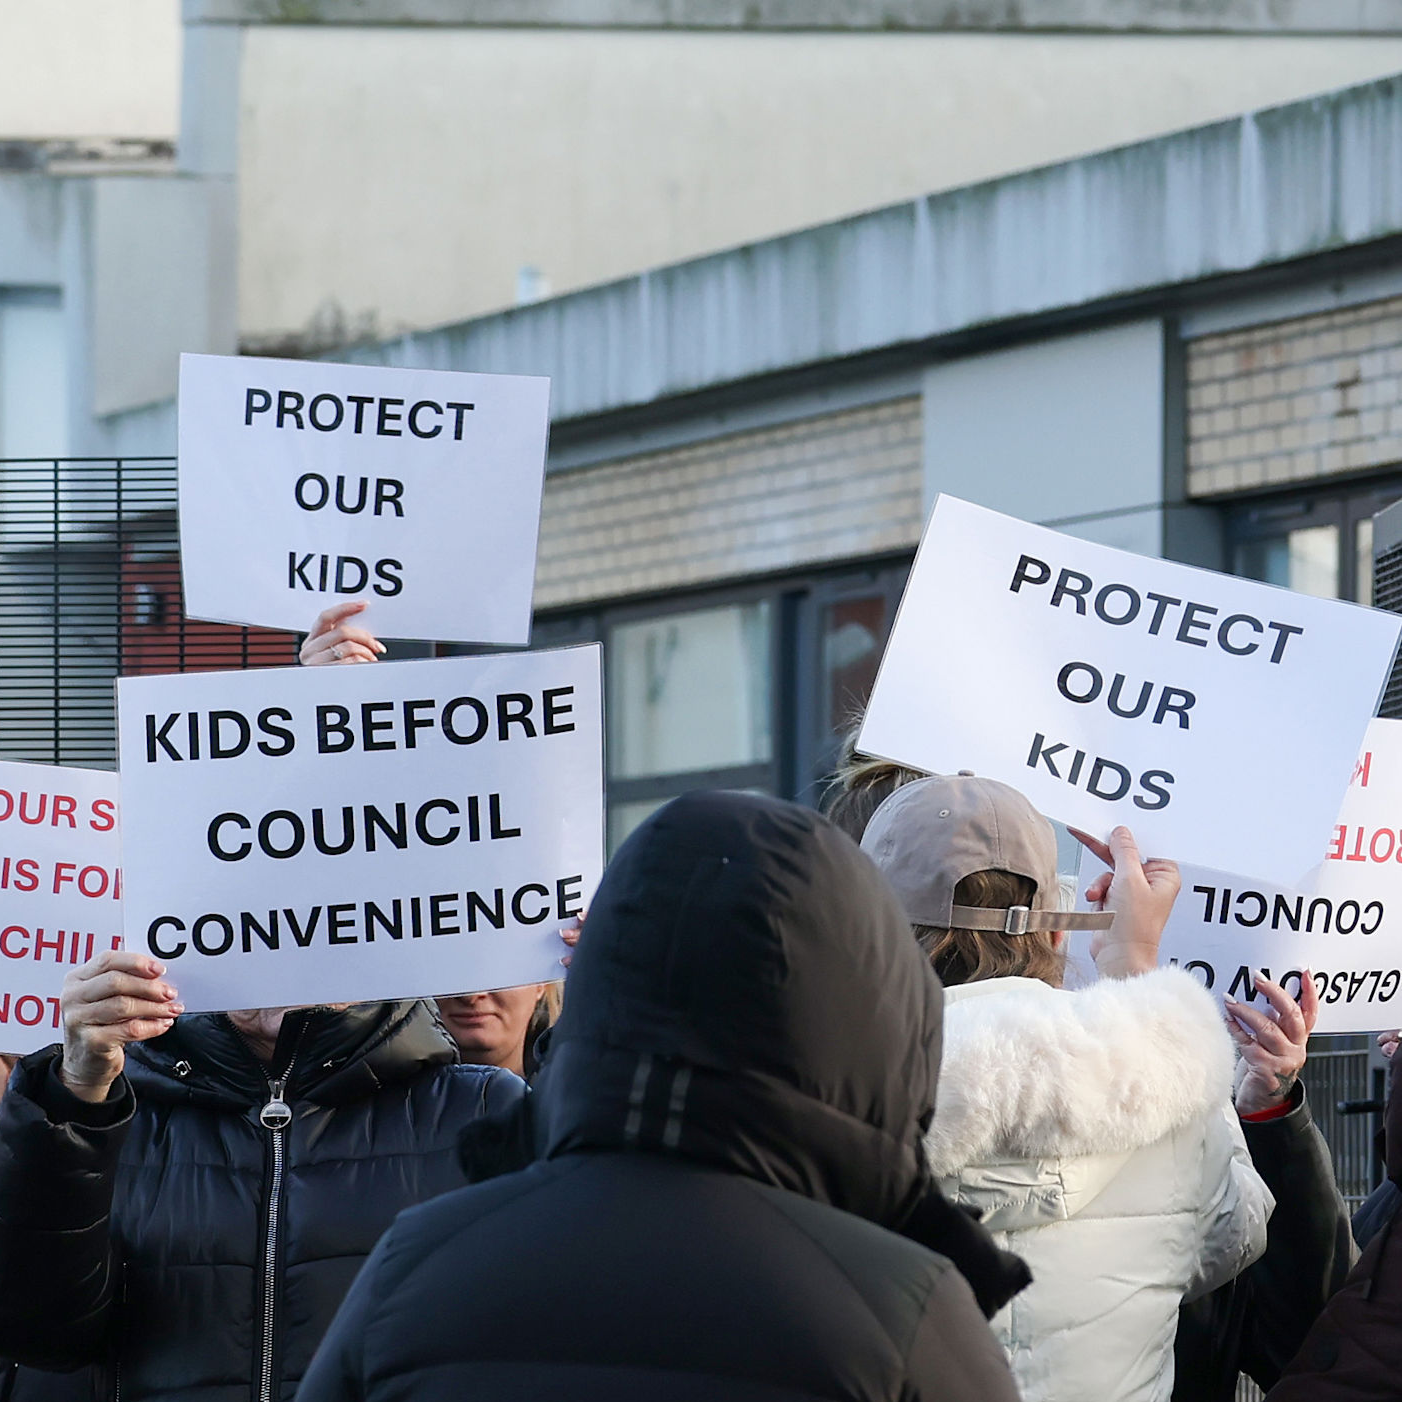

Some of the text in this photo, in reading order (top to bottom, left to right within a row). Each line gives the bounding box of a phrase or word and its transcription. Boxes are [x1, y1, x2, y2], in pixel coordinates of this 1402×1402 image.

[245, 389, 474, 440] PROTECT
[295, 473, 404, 517] OUR
[289, 552, 402, 596] KIDS
[1010, 555, 1303, 664] PROTECT
[146, 686, 575, 762] KIDS BEFORE
[1057, 662, 1195, 729] OUR
[1027, 733, 1174, 810] KIDS
[208, 794, 521, 861] COUNCIL
[1, 857, 39, 891] IS
[148, 875, 582, 959] CONVENIENCE
[1193, 886, 1383, 935] COUNCIL
